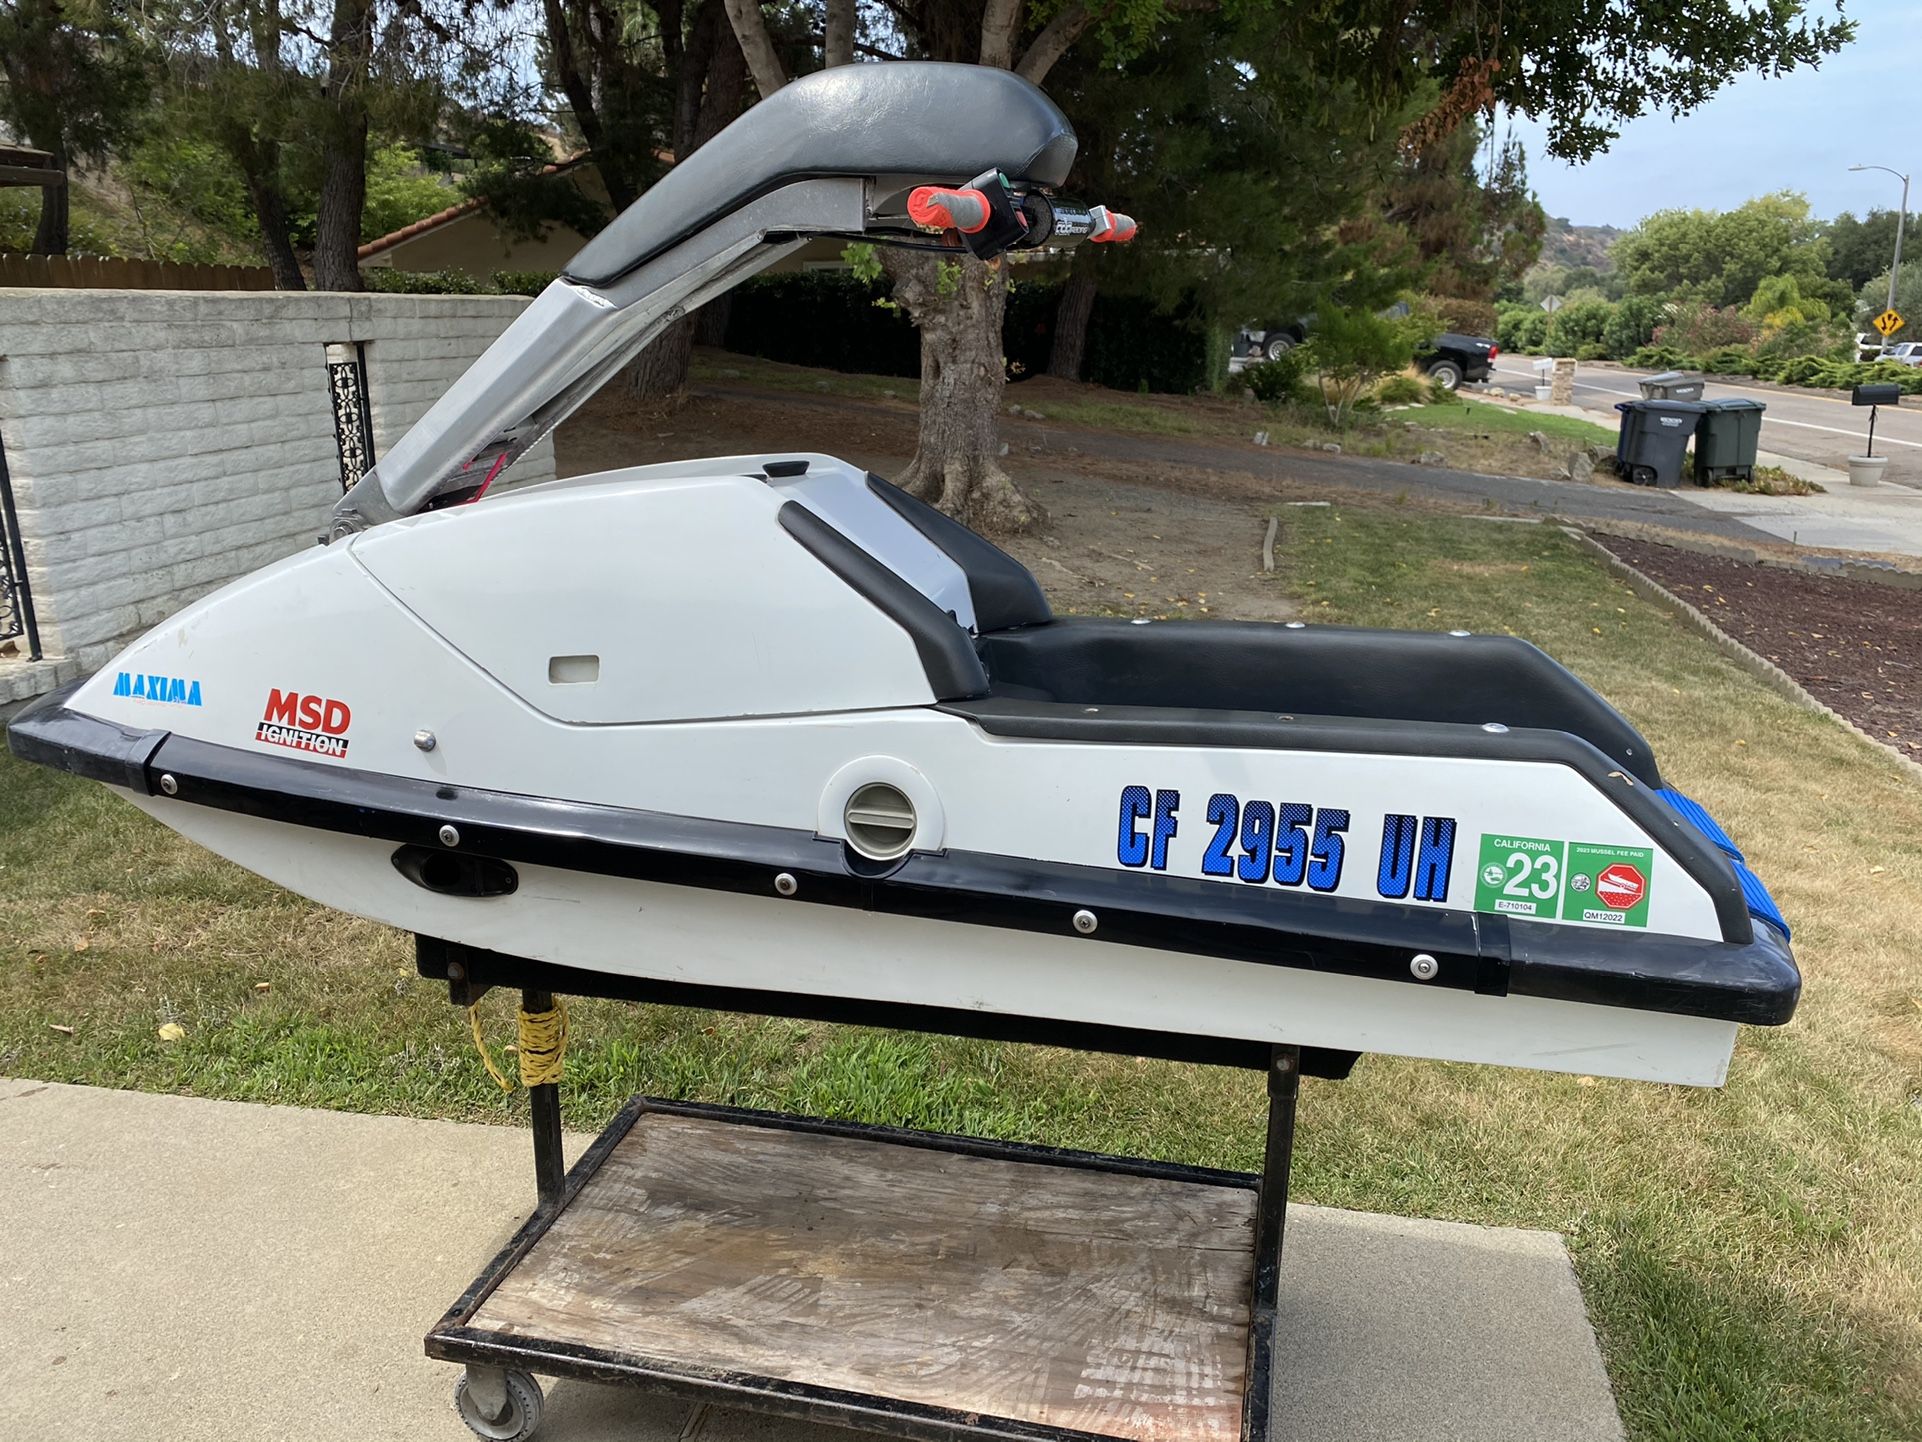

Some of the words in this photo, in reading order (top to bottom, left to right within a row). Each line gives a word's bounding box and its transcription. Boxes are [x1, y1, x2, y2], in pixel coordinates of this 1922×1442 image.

[113, 672, 202, 706] MAXIMA
[263, 688, 352, 735] MSD
[260, 724, 344, 757] IGNITION
[1117, 785, 1181, 871] CF
[1201, 793, 1351, 893] 2955
[1376, 813, 1457, 902] UH
[1494, 838, 1551, 852] CALIFORNIA
[1591, 848, 1616, 856] MUSSEL
[1502, 852, 1559, 900] 23
[1498, 901, 1532, 911] E-710104
[1584, 911, 1623, 922] QM12022
